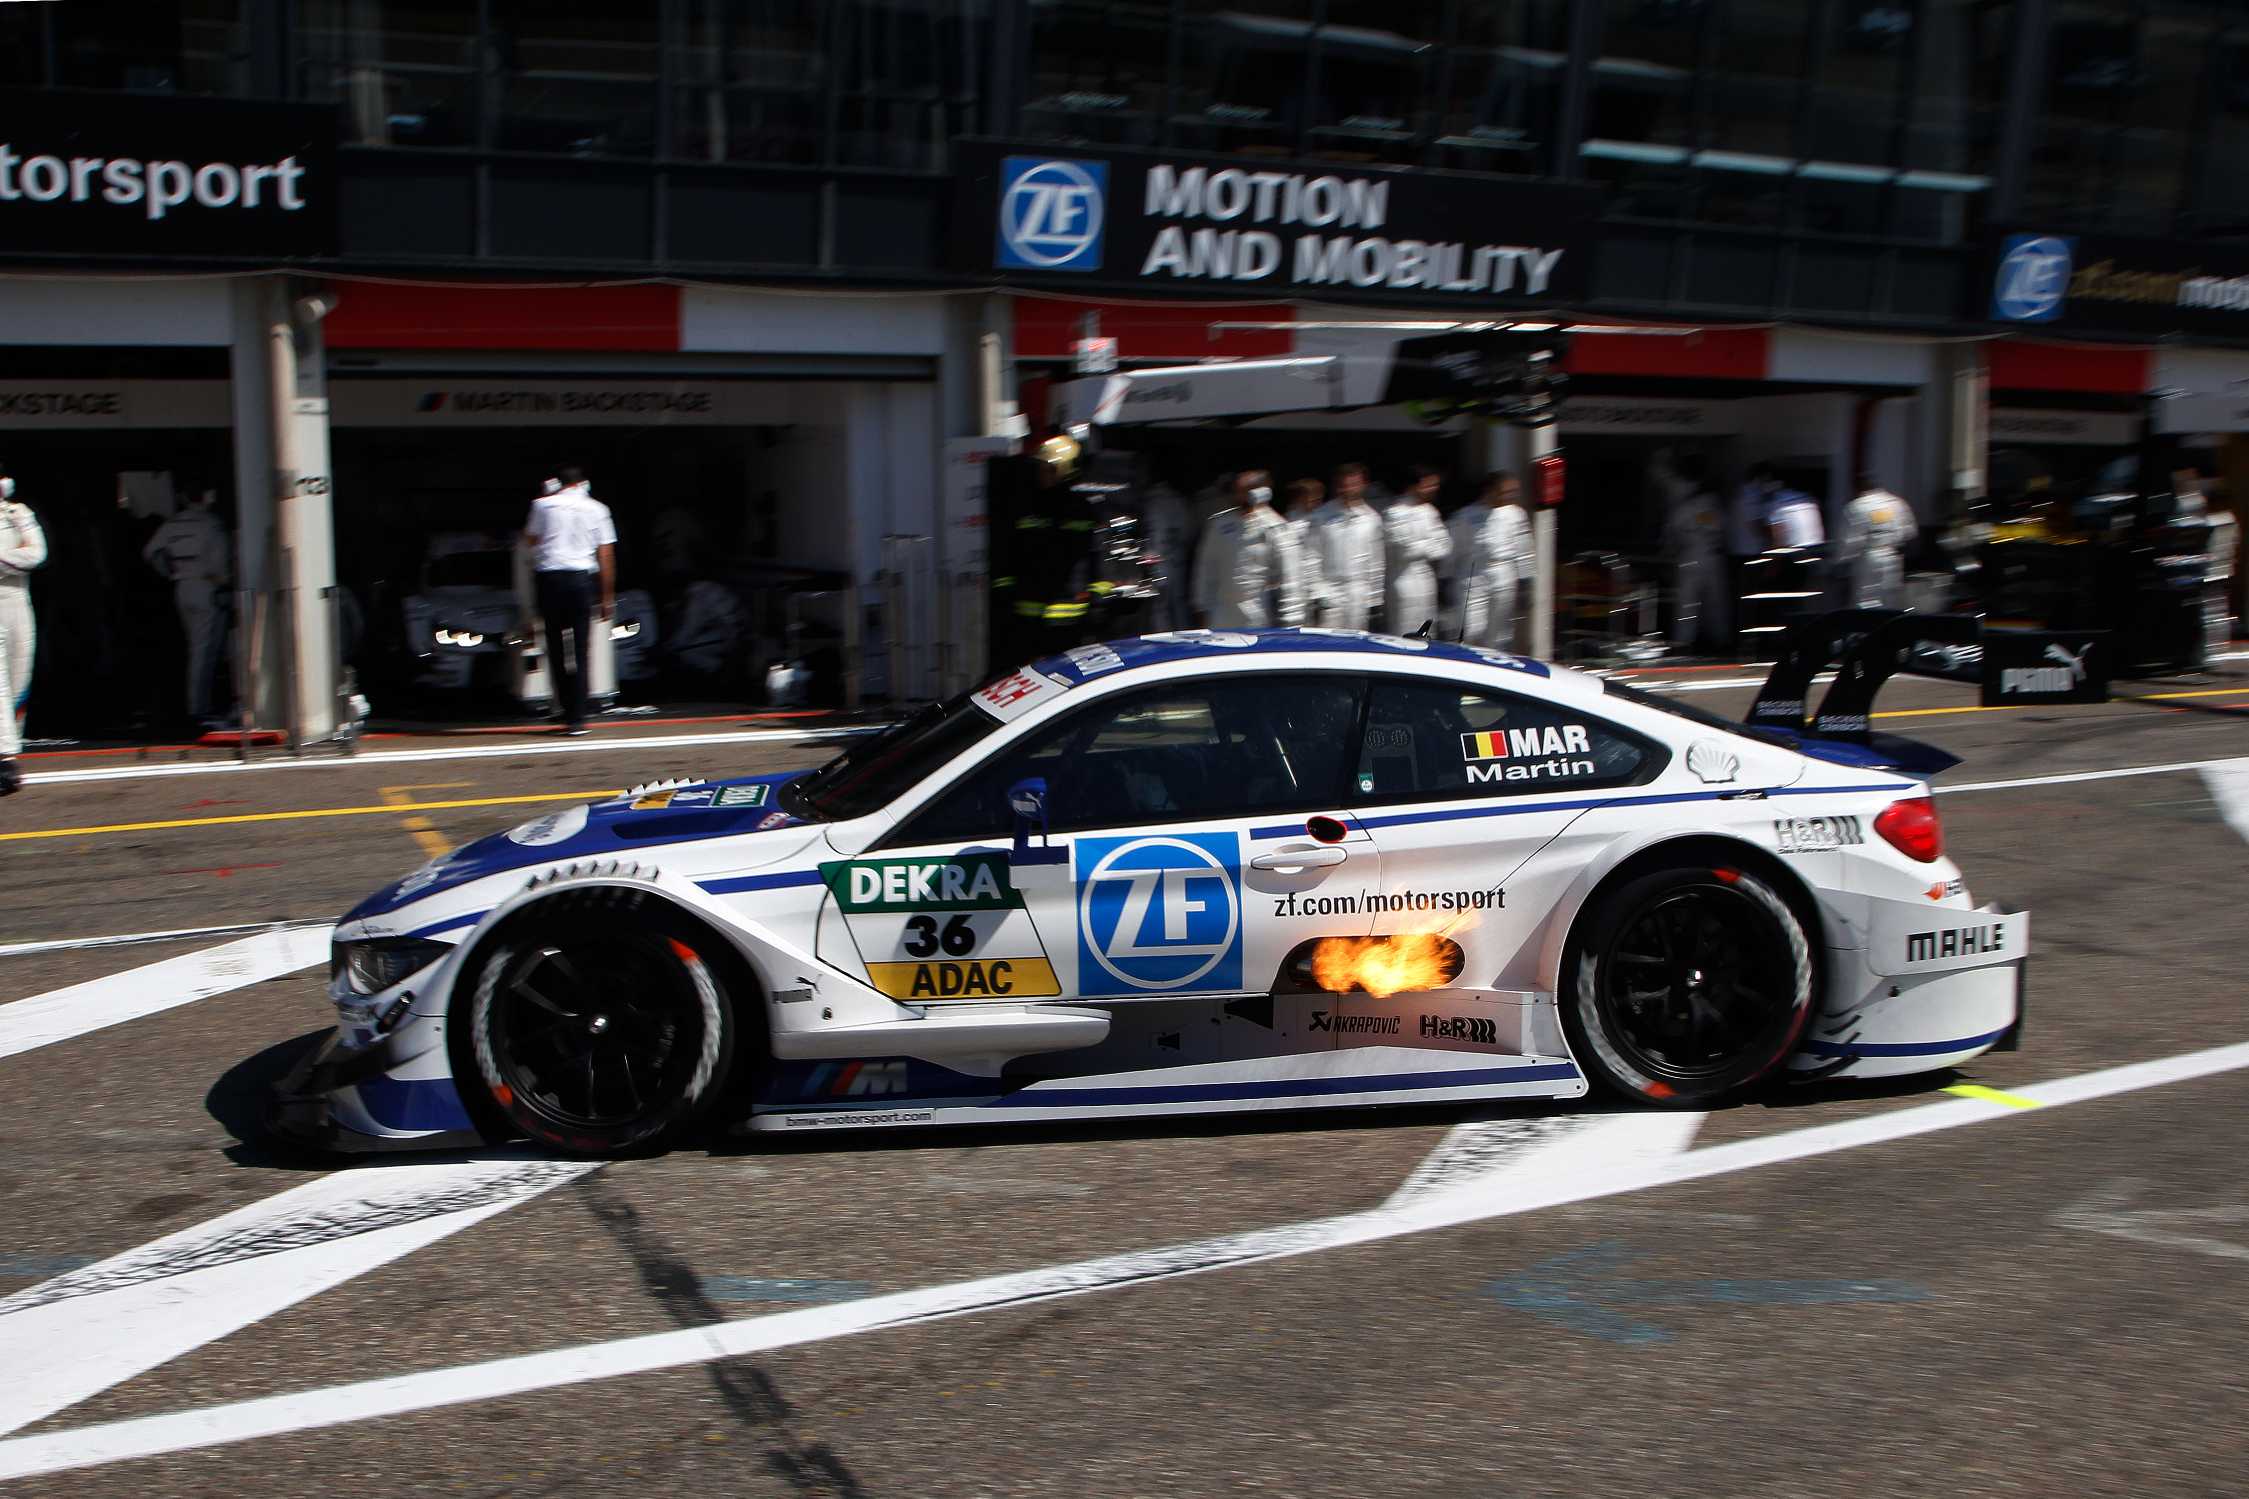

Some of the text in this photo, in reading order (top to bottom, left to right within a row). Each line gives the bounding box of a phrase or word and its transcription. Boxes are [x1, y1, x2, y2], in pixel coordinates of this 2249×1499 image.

[1144, 163, 1390, 230] MOTION
[1141, 226, 1565, 297] AND MOBILITY
[2001, 667, 2075, 694] PUMA
[1508, 724, 1591, 758] MAR
[1466, 757, 1595, 784] Martin
[849, 863, 1002, 905] DEKRA
[1274, 887, 1506, 918] zf.com/motorsport
[903, 913, 977, 959] 36
[1907, 922, 2005, 962] MAHLE
[910, 960, 1015, 998] ADAC
[785, 1110, 932, 1128] bmw-motorsport.com
